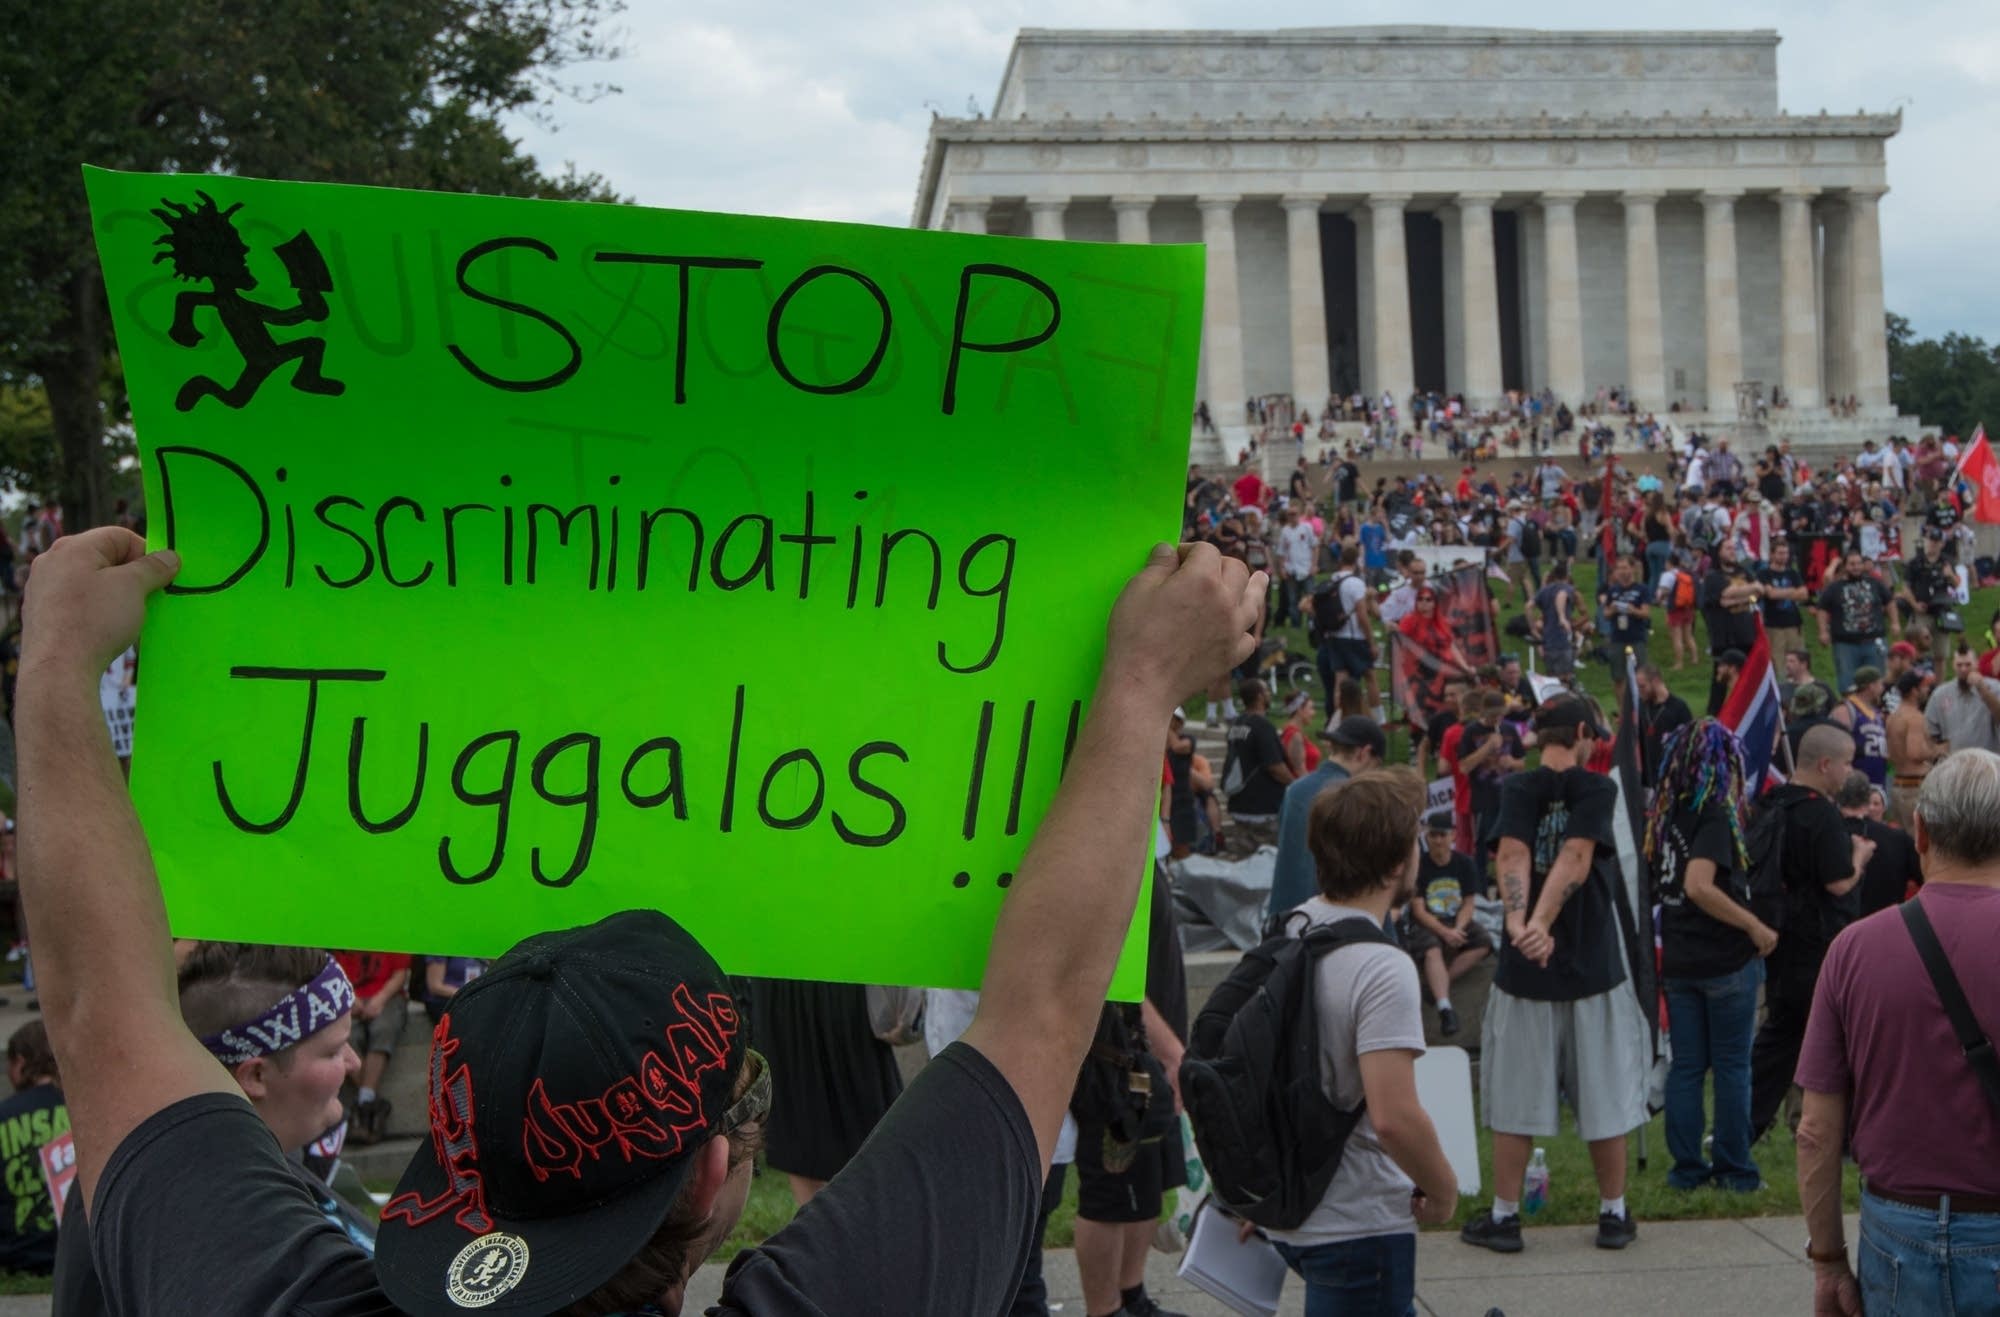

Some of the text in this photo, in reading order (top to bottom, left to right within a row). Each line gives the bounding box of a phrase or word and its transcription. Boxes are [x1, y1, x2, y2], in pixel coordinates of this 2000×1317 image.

[448, 237, 1061, 415] STOP
[156, 446, 1016, 674] Discriminating
[213, 666, 909, 888] Juggalos
[0, 1104, 72, 1159] INSA
